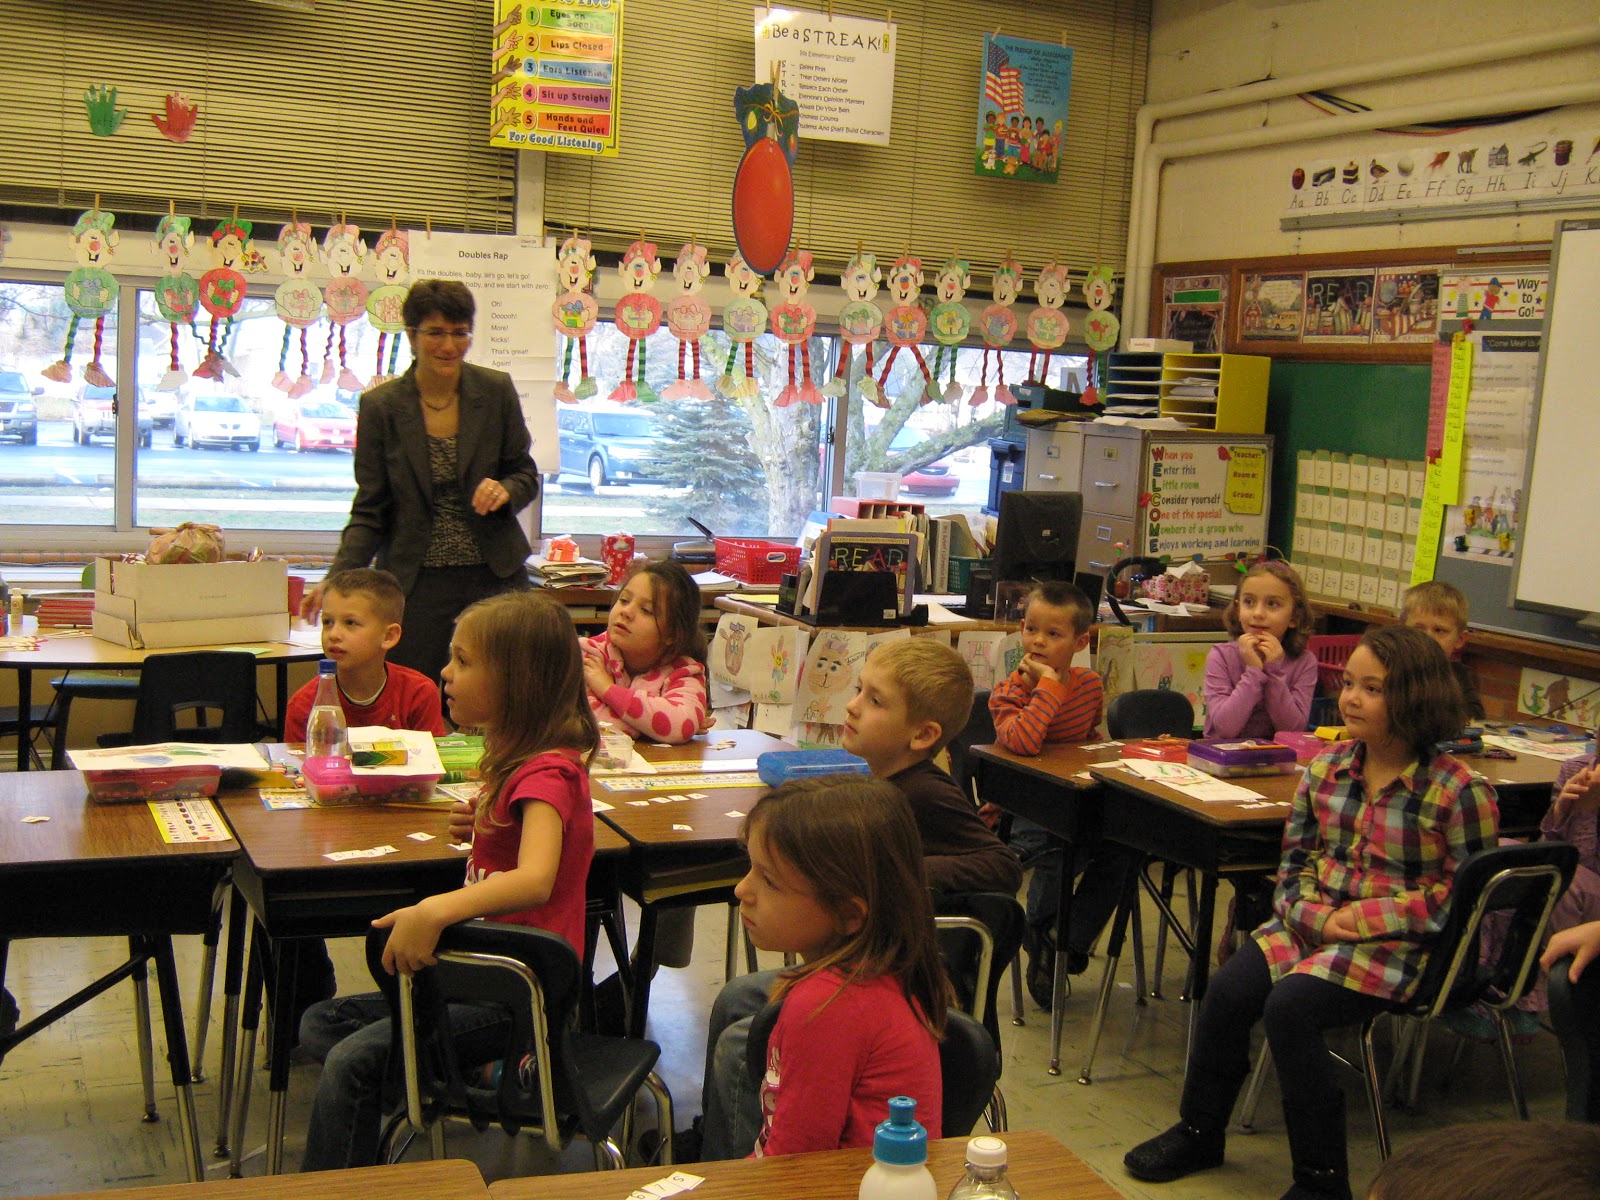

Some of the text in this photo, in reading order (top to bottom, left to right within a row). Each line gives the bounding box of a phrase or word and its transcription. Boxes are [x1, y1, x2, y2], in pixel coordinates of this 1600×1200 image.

[550, 9, 570, 19] Eyes
[772, 24, 881, 51] Be a STREAK!
[528, 36, 604, 51] 2 Lips Closed
[526, 62, 608, 79] 3 Ears Listening
[525, 88, 609, 103] 4 Sit up Straight
[526, 113, 594, 124] 5 Hands and
[558, 123, 605, 135] Feet Quiet
[509, 131, 603, 152] For Good Listening
[1290, 166, 1600, 208] Aa Bb Cc Dd Ee Ff Gg Hh Ii Jj K
[458, 250, 508, 260] Doubles Rap
[465, 271, 482, 279] baby,
[465, 281, 482, 289] baby,
[1516, 278, 1540, 292] Way
[1522, 293, 1533, 303] to
[1518, 307, 1535, 318] Go!
[491, 336, 509, 344] Kicks!
[491, 348, 529, 356] That's great!
[1181, 451, 1193, 461] you
[1234, 451, 1262, 459] Teacher:
[1182, 464, 1196, 475] this
[1180, 481, 1200, 490] room
[1190, 494, 1221, 506] yourself
[1232, 491, 1255, 499] Grade:
[1171, 510, 1180, 519] of
[1182, 510, 1194, 519] the
[1197, 509, 1222, 520] special
[1188, 525, 1196, 533] of
[1206, 525, 1226, 535] group
[1228, 523, 1244, 533] who
[1181, 539, 1212, 549] working
[1214, 538, 1228, 547] and
[835, 547, 904, 570] READ
[1307, 573, 1319, 585] 23
